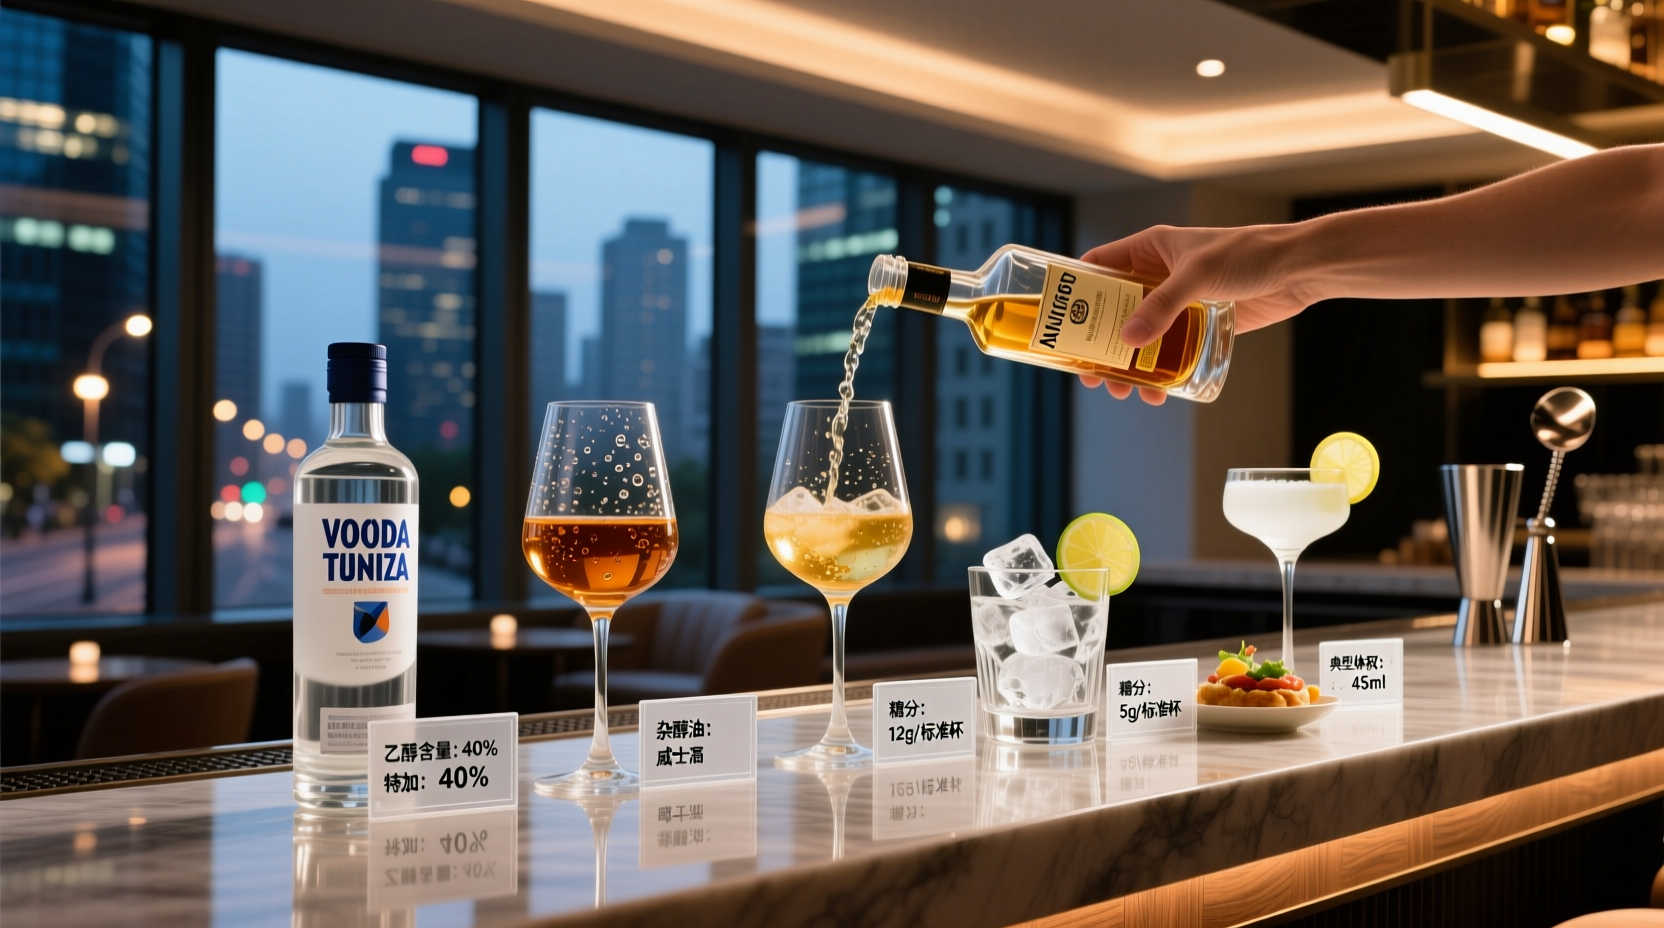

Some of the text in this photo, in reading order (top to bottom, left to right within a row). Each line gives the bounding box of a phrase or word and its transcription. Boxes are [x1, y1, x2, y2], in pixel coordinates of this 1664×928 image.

[322, 518, 410, 549] VOODA
[322, 552, 409, 582] TUNIZA
[1352, 674, 1386, 690] 45ml
[1120, 700, 1182, 723] 5g/标准杯
[889, 721, 964, 745] 12g/标准杯
[438, 765, 489, 789] 40%
